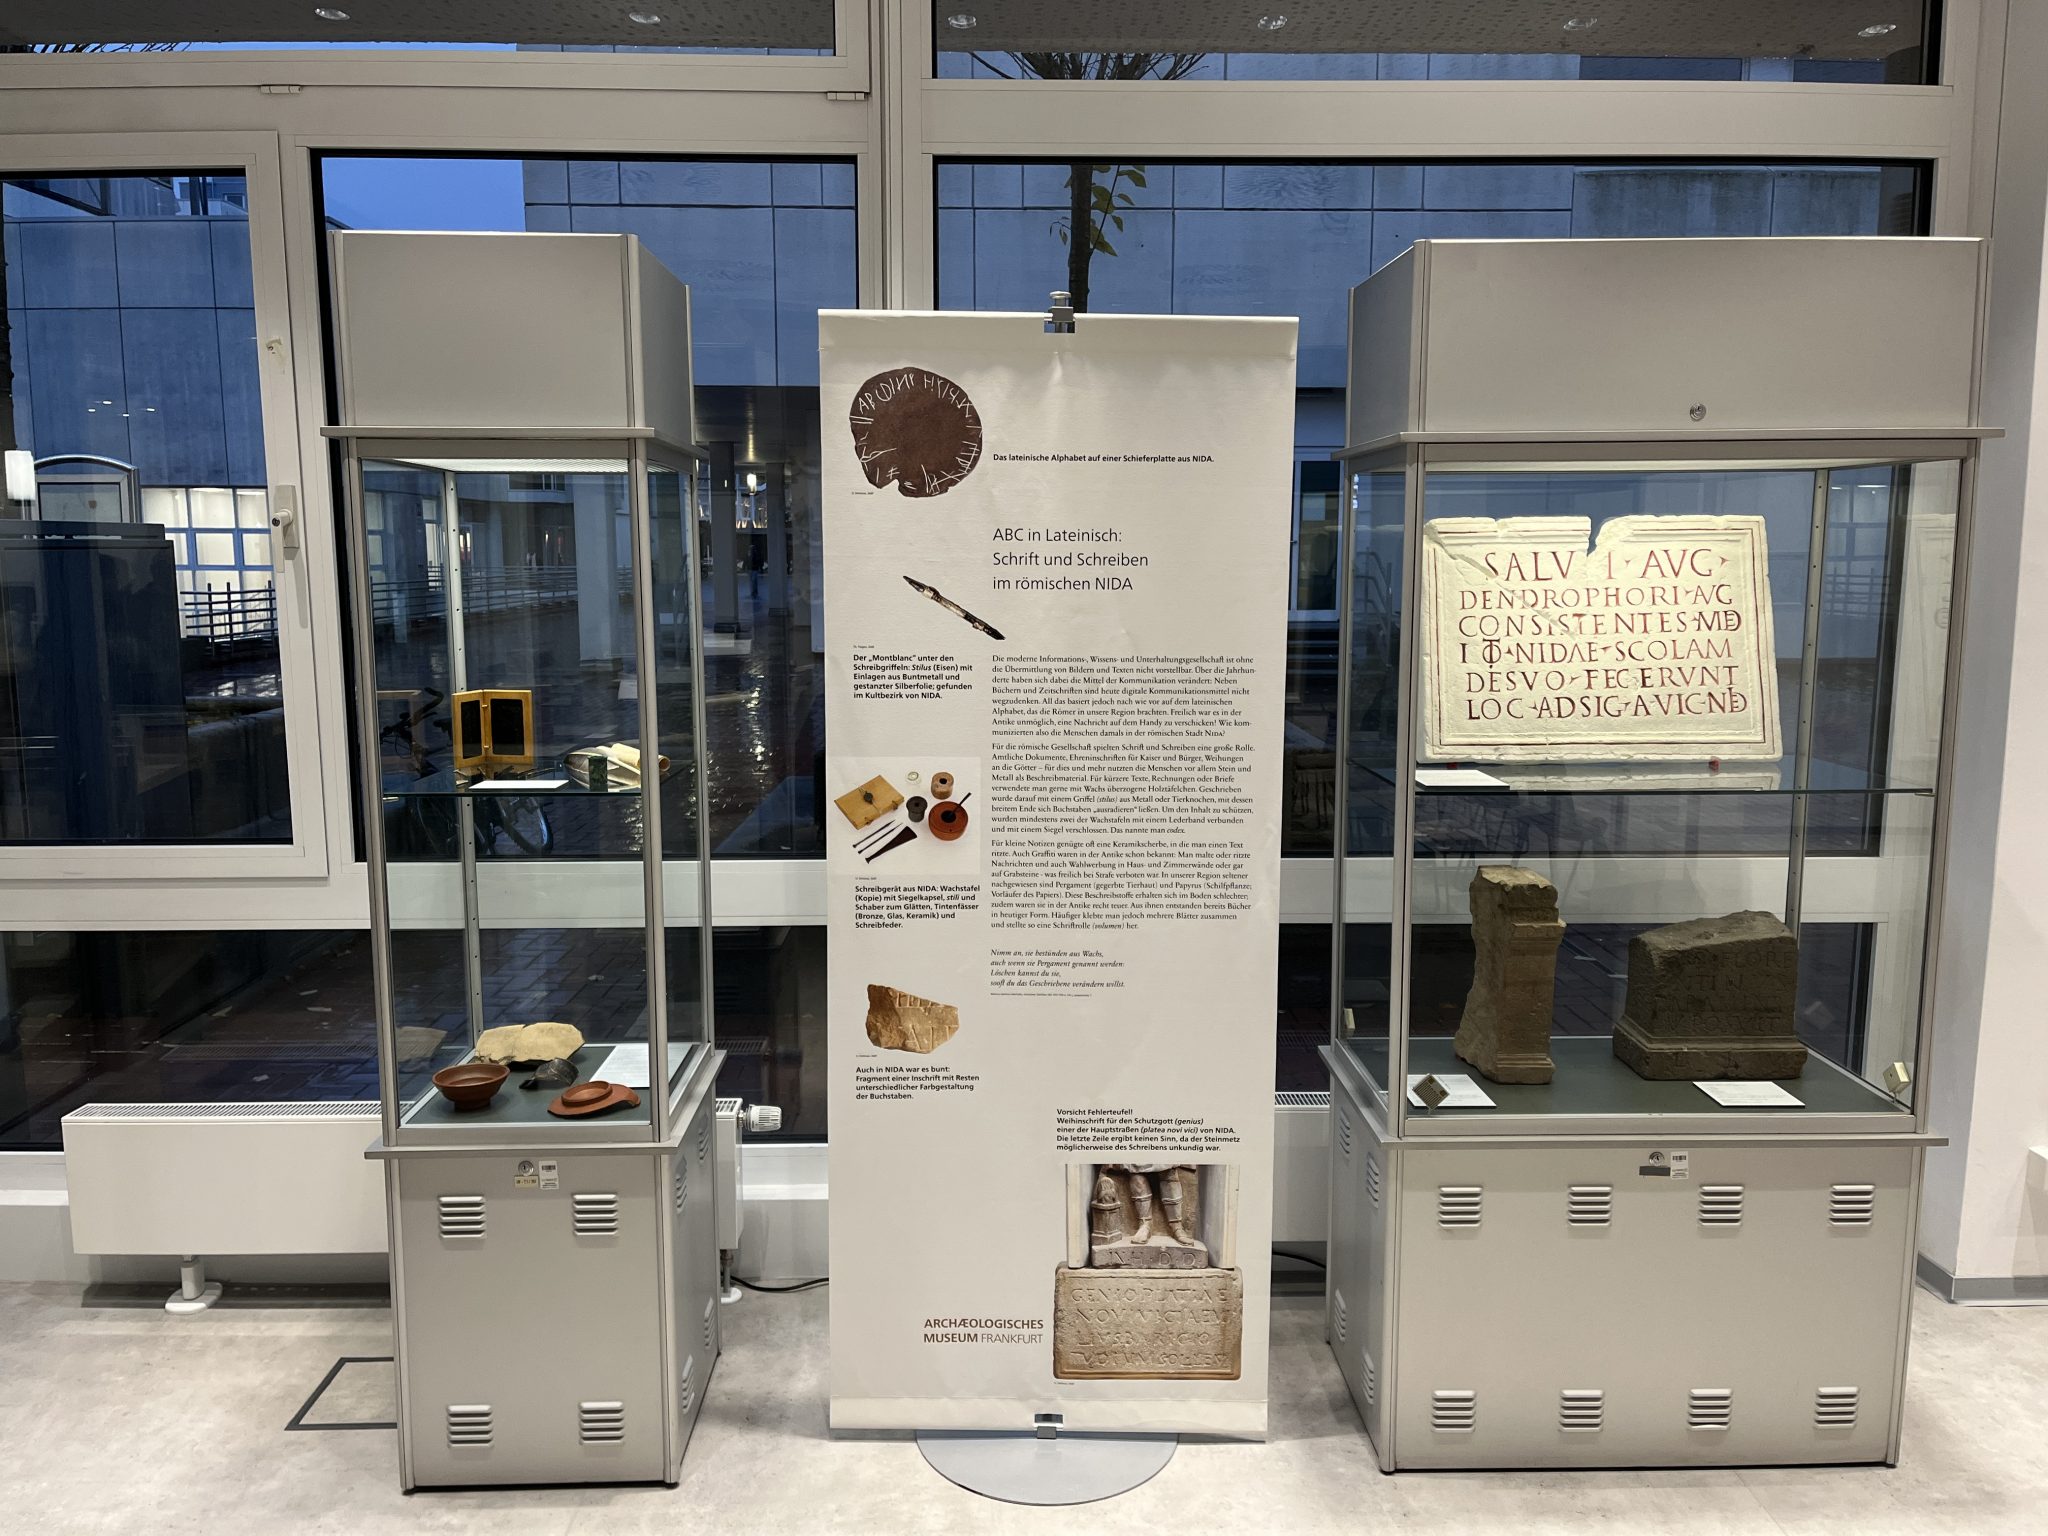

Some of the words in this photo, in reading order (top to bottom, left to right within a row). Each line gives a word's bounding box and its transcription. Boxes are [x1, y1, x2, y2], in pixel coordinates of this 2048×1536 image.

[1050, 454, 1086, 463] Alphabet
[1087, 454, 1101, 462] auf
[1123, 455, 1176, 464] Schieferplatte
[992, 528, 1024, 542] ABC
[1028, 528, 1041, 541] in
[1046, 528, 1122, 542] Lateinisch:
[993, 552, 1040, 566] Schrift
[1044, 552, 1072, 566] und
[1077, 552, 1148, 566] Schreiben
[993, 576, 1011, 589] im
[1015, 576, 1091, 590] römischen
[1095, 577, 1133, 590] NIDA
[853, 663, 910, 672] Schreibgriffeln:
[933, 664, 959, 672] (Eisen)
[853, 673, 886, 682] Einlagen
[853, 683, 894, 691] gestanzter
[894, 682, 935, 690] Silberfolie;
[936, 682, 973, 691] gefunden
[855, 886, 902, 894] Schreibgerät
[855, 894, 882, 903] (Kopie)
[897, 894, 946, 902] Siegelkapsel,
[906, 912, 940, 920] Keramik)
[855, 1076, 891, 1084] Fragment
[911, 1074, 941, 1082] Inschrift
[955, 1074, 980, 1082] Resten
[855, 1082, 919, 1091] unterschiedlicher
[919, 1083, 974, 1092] Farbgestaltung
[869, 1092, 913, 1100] Buchstaben.
[1134, 1118, 1174, 1126] Schutzgott
[1174, 1118, 1204, 1126] (genius)
[1090, 1126, 1139, 1134] Hauptstraßen
[1140, 1126, 1166, 1134] (platea
[1110, 1135, 1133, 1143] ergibt
[1160, 1135, 1178, 1143] Sinn,
[1056, 1144, 1114, 1152] möglicherweise
[1169, 1144, 1204, 1152] unkundig
[923, 1333, 978, 1343] MUSEUM
[981, 1334, 1043, 1344] FRANKFURT
